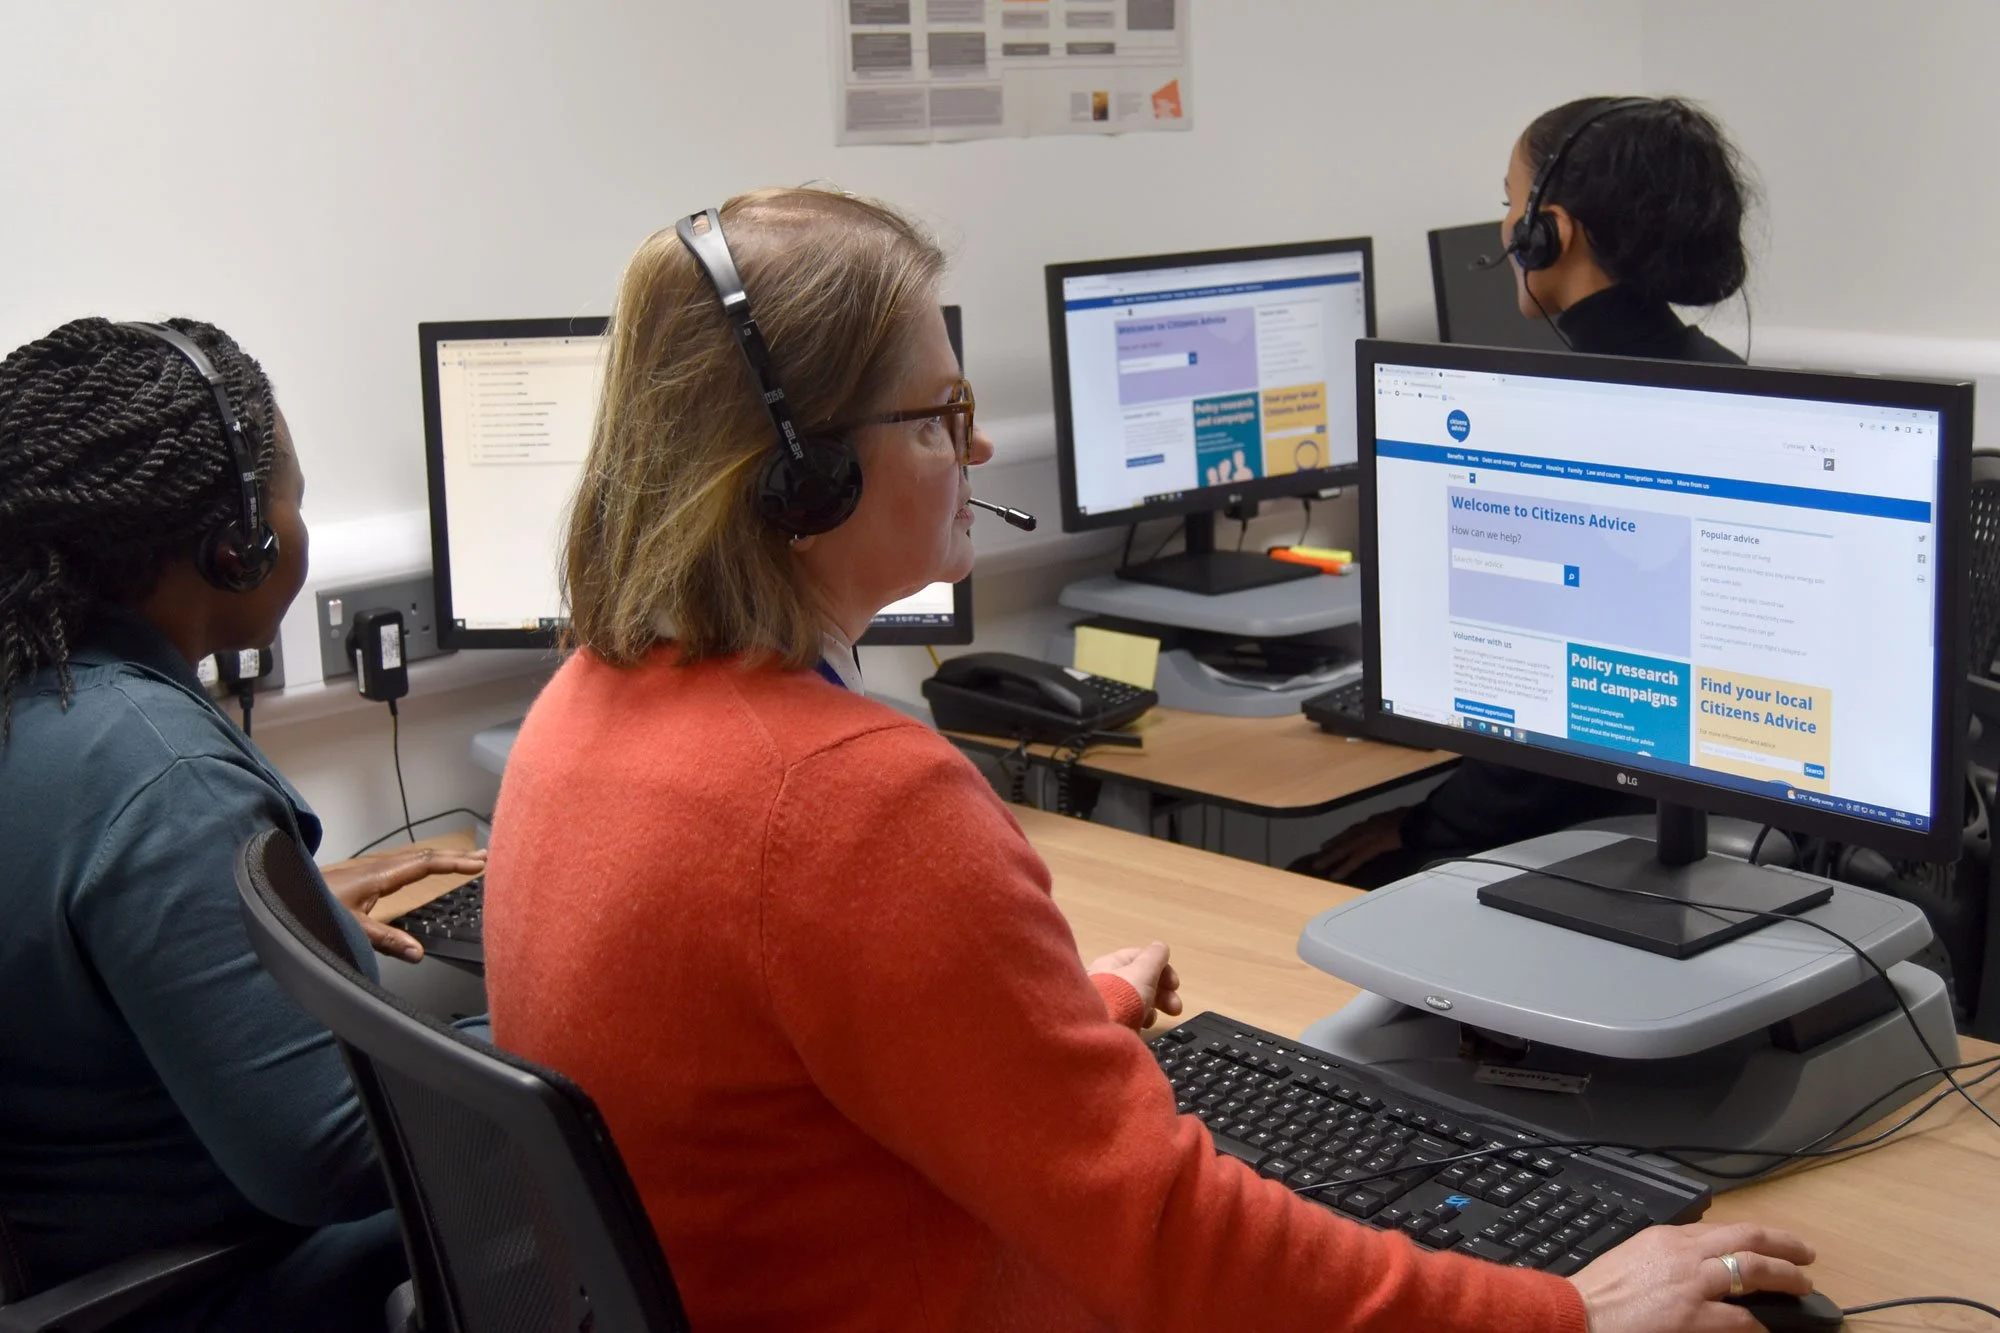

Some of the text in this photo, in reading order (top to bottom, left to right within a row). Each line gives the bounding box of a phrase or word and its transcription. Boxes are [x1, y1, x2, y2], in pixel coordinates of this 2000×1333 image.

[1447, 453, 1464, 461] Benefits
[1502, 459, 1517, 468] money
[1520, 461, 1543, 470] Consumer
[1546, 464, 1564, 474] Housing
[1568, 467, 1583, 476] Family
[1606, 471, 1620, 479] courts
[1624, 473, 1653, 485] Immigration
[1657, 477, 1673, 485] Health
[1690, 481, 1702, 489] from
[1452, 494, 1636, 533] Welcome to Citizens Advice
[1452, 525, 1522, 546] How can we help?
[1701, 529, 1760, 545] Popular advice
[1453, 631, 1485, 644] Volunteer
[1487, 637, 1503, 647] with
[1572, 653, 1612, 678] Policy
[1616, 661, 1678, 686] research
[1572, 674, 1597, 692] and
[1601, 679, 1677, 712] campaigns
[1701, 676, 1812, 711] Find your local
[1465, 704, 1484, 714] volunteer
[1485, 708, 1513, 721] opportunities
[1588, 706, 1600, 714] latest
[1701, 698, 1816, 735] Citizens Advice
[1571, 713, 1582, 721] Read
[1591, 717, 1603, 727] policy
[1605, 720, 1623, 729] research
[1624, 724, 1634, 732] work
[1590, 728, 1602, 736] about
[1611, 732, 1625, 742] impact
[1640, 738, 1654, 747] advice
[1806, 766, 1823, 776] Search
